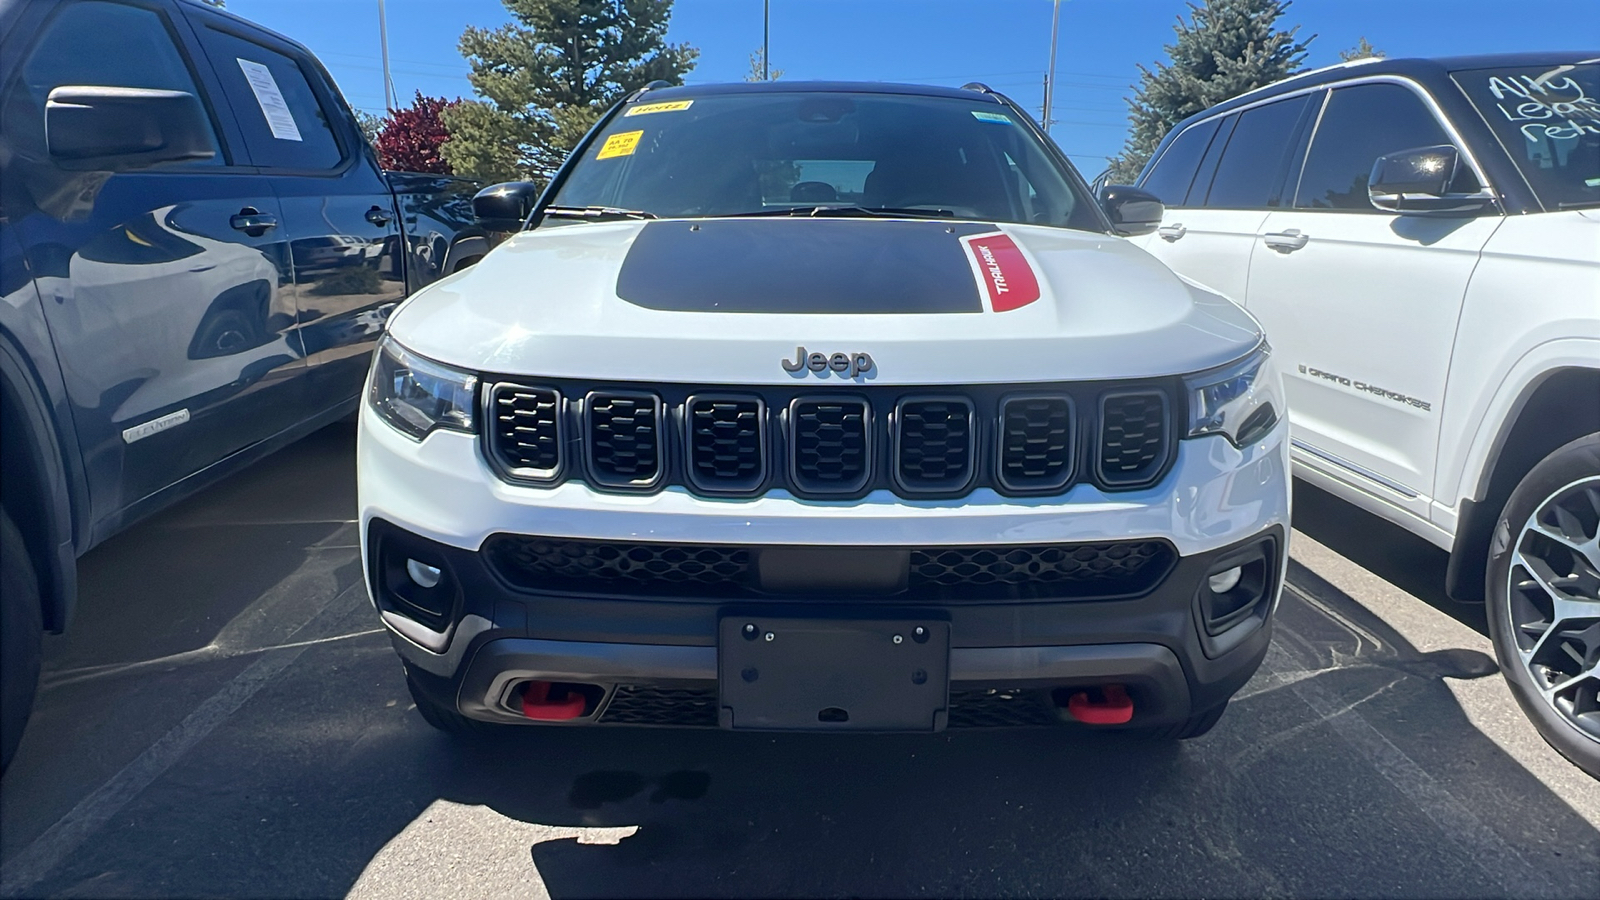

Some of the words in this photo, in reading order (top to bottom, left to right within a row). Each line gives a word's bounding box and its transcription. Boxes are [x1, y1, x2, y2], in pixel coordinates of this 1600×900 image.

[635, 103, 684, 114] Hertz
[977, 245, 1009, 295] TRAILHAWK
[781, 346, 873, 377] Jeep
[1308, 367, 1351, 386] GRAND
[1353, 380, 1431, 412] CHEROKEE
